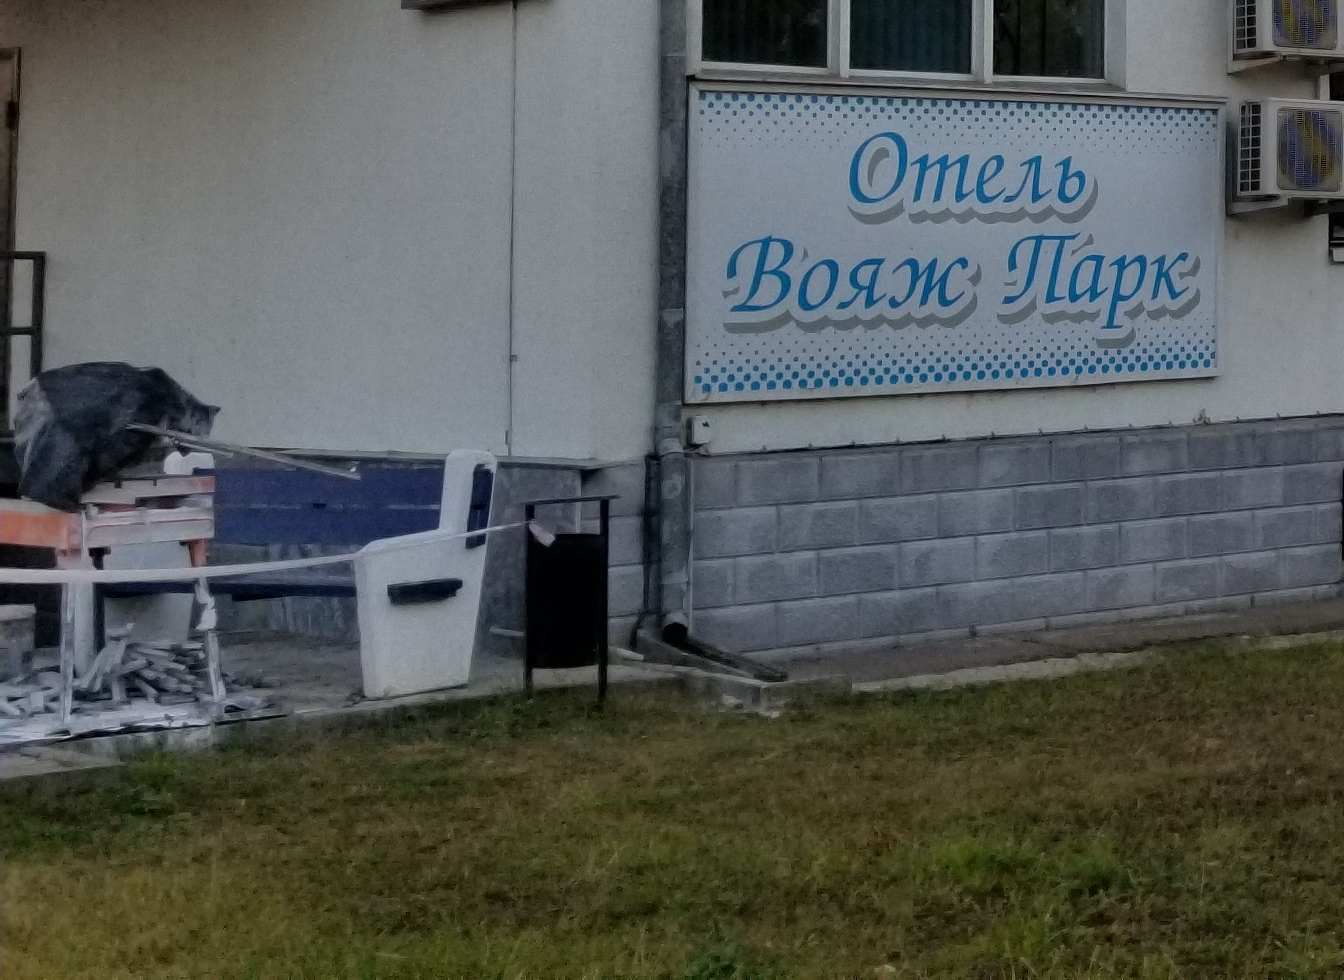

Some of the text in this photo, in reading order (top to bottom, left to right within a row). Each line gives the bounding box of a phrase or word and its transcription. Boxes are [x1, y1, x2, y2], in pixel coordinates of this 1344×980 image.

[848, 131, 1087, 206] Отель
[726, 232, 1190, 329] Вояж Парк
